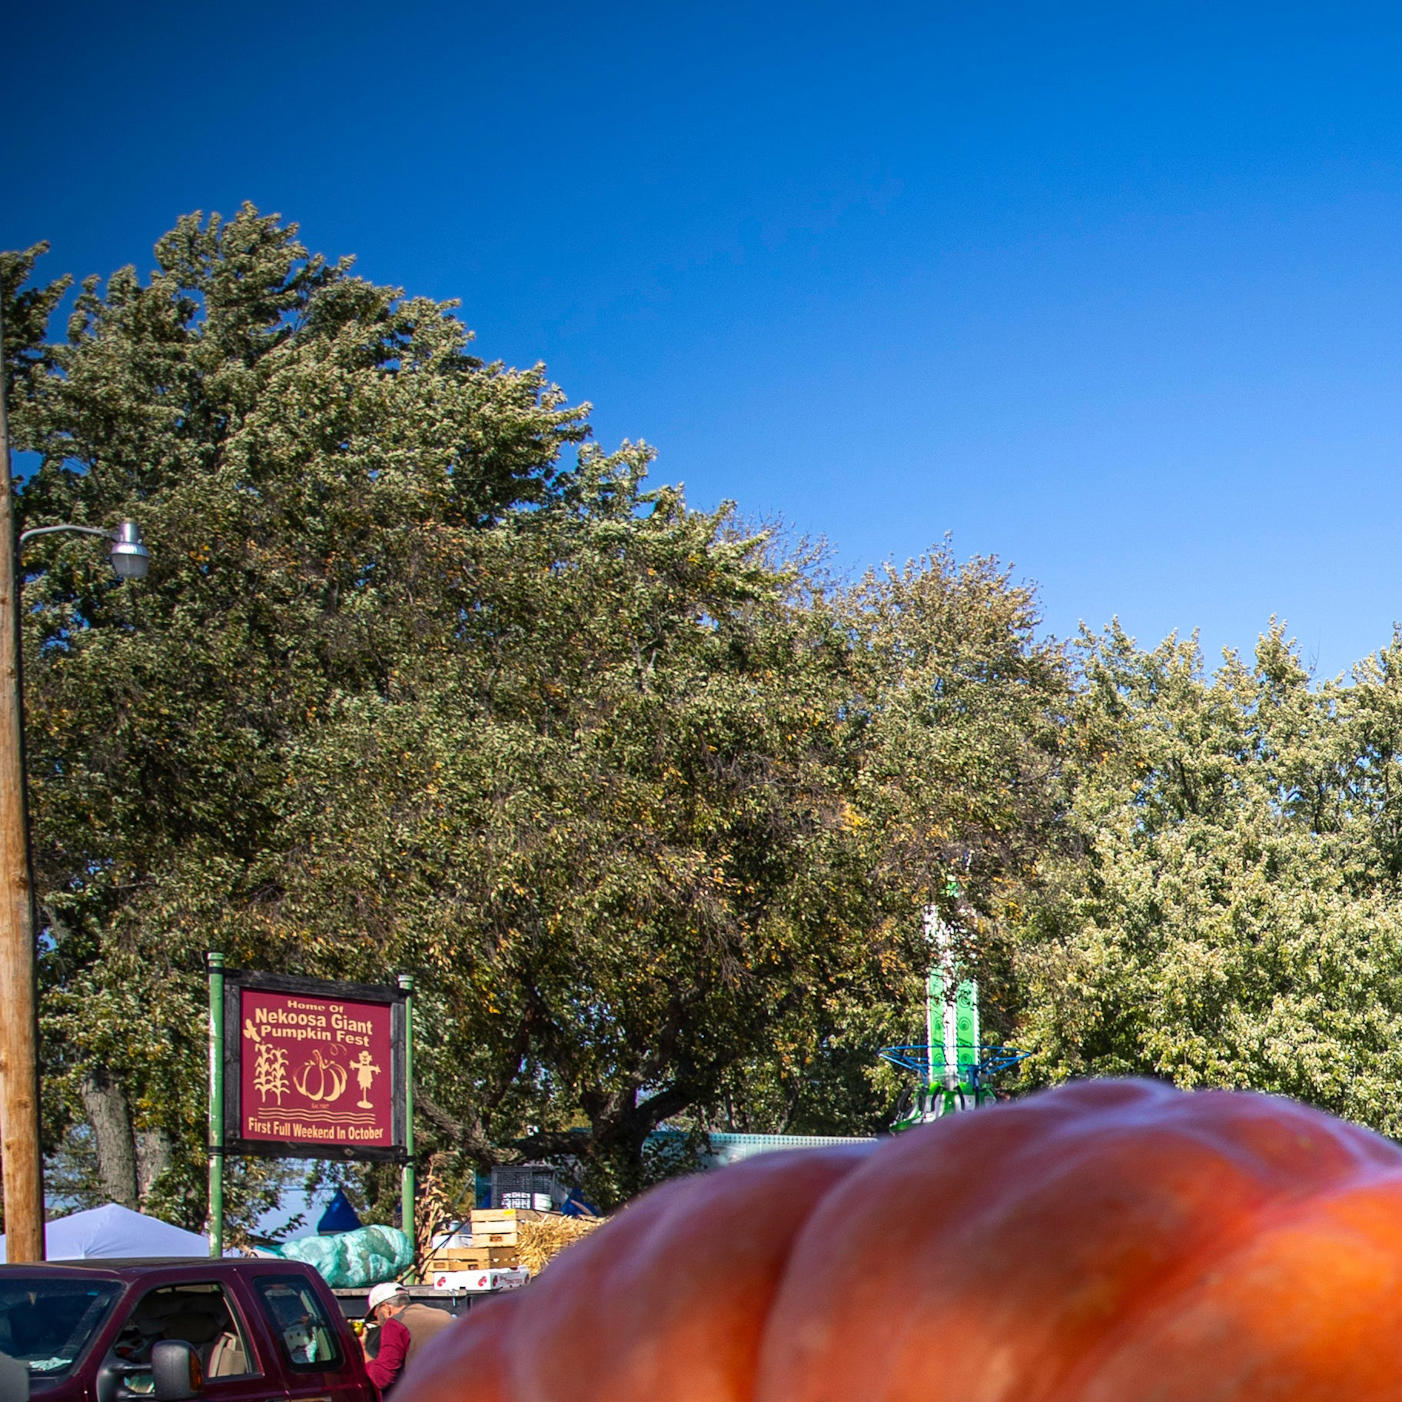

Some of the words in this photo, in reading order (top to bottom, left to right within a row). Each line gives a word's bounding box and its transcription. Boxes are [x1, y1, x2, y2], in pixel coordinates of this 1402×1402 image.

[287, 1000, 326, 1012] Home
[329, 1004, 344, 1013] Of
[255, 1008, 327, 1027] Nekoosa
[331, 1013, 373, 1035] Giant
[261, 1025, 331, 1041] Pumpkin
[336, 1030, 370, 1047] Fest
[248, 1117, 271, 1134] First
[273, 1121, 291, 1136] Full
[292, 1123, 334, 1139] Weekend
[337, 1127, 346, 1139] In
[348, 1126, 384, 1139] October
